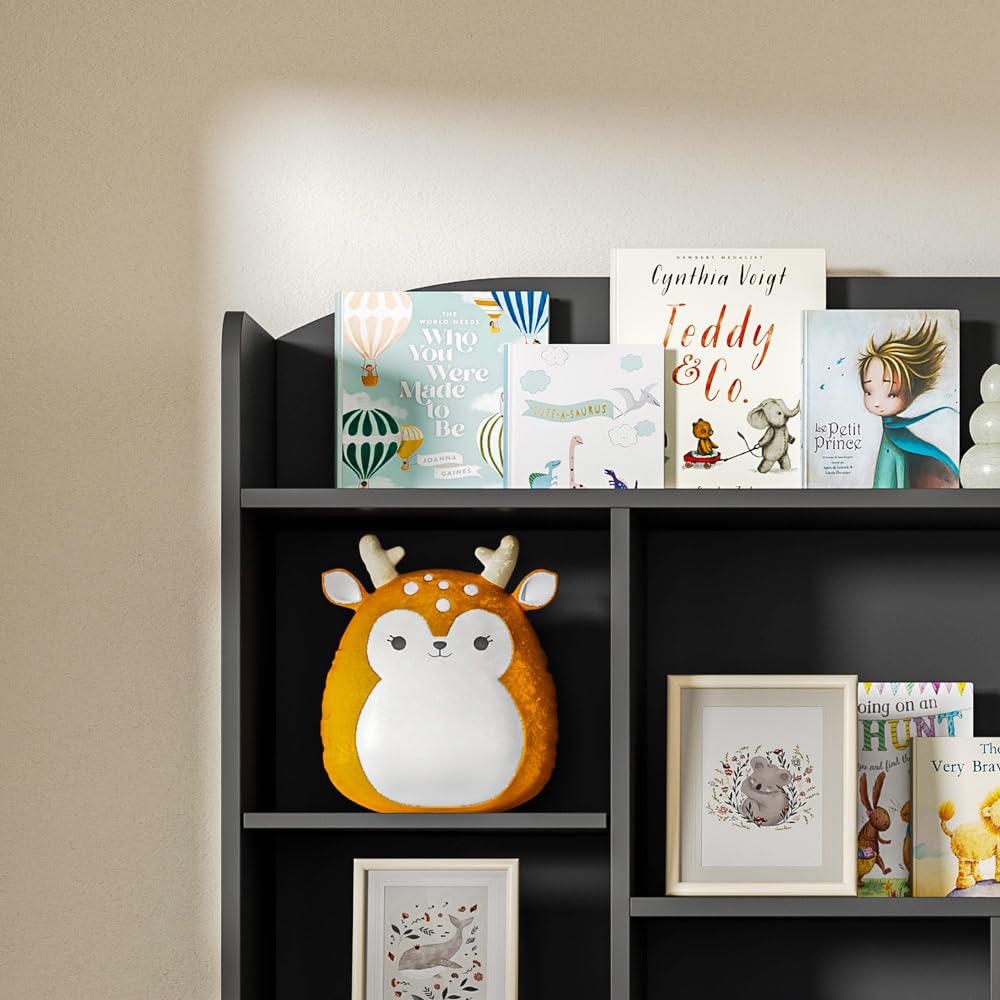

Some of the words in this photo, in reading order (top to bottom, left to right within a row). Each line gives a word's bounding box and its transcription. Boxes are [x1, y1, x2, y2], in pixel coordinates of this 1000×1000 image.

[651, 264, 728, 296] Cynthia
[740, 264, 787, 296] Voigt
[422, 328, 478, 353] Who
[663, 303, 774, 370] Teddy
[408, 344, 453, 362] You
[426, 364, 489, 382] Were
[672, 354, 701, 386] &
[704, 358, 748, 403] Co.
[399, 381, 466, 406] Made
[427, 399, 450, 419] to
[435, 420, 465, 437] Be
[828, 422, 861, 439] Petit
[814, 436, 862, 453] Prince
[423, 455, 457, 463] JOANNA
[441, 468, 472, 477] GAINES
[857, 700, 890, 717] oing
[895, 700, 915, 712] on
[919, 698, 938, 710] an
[861, 710, 962, 751] HUNT
[931, 760, 965, 777] Very
